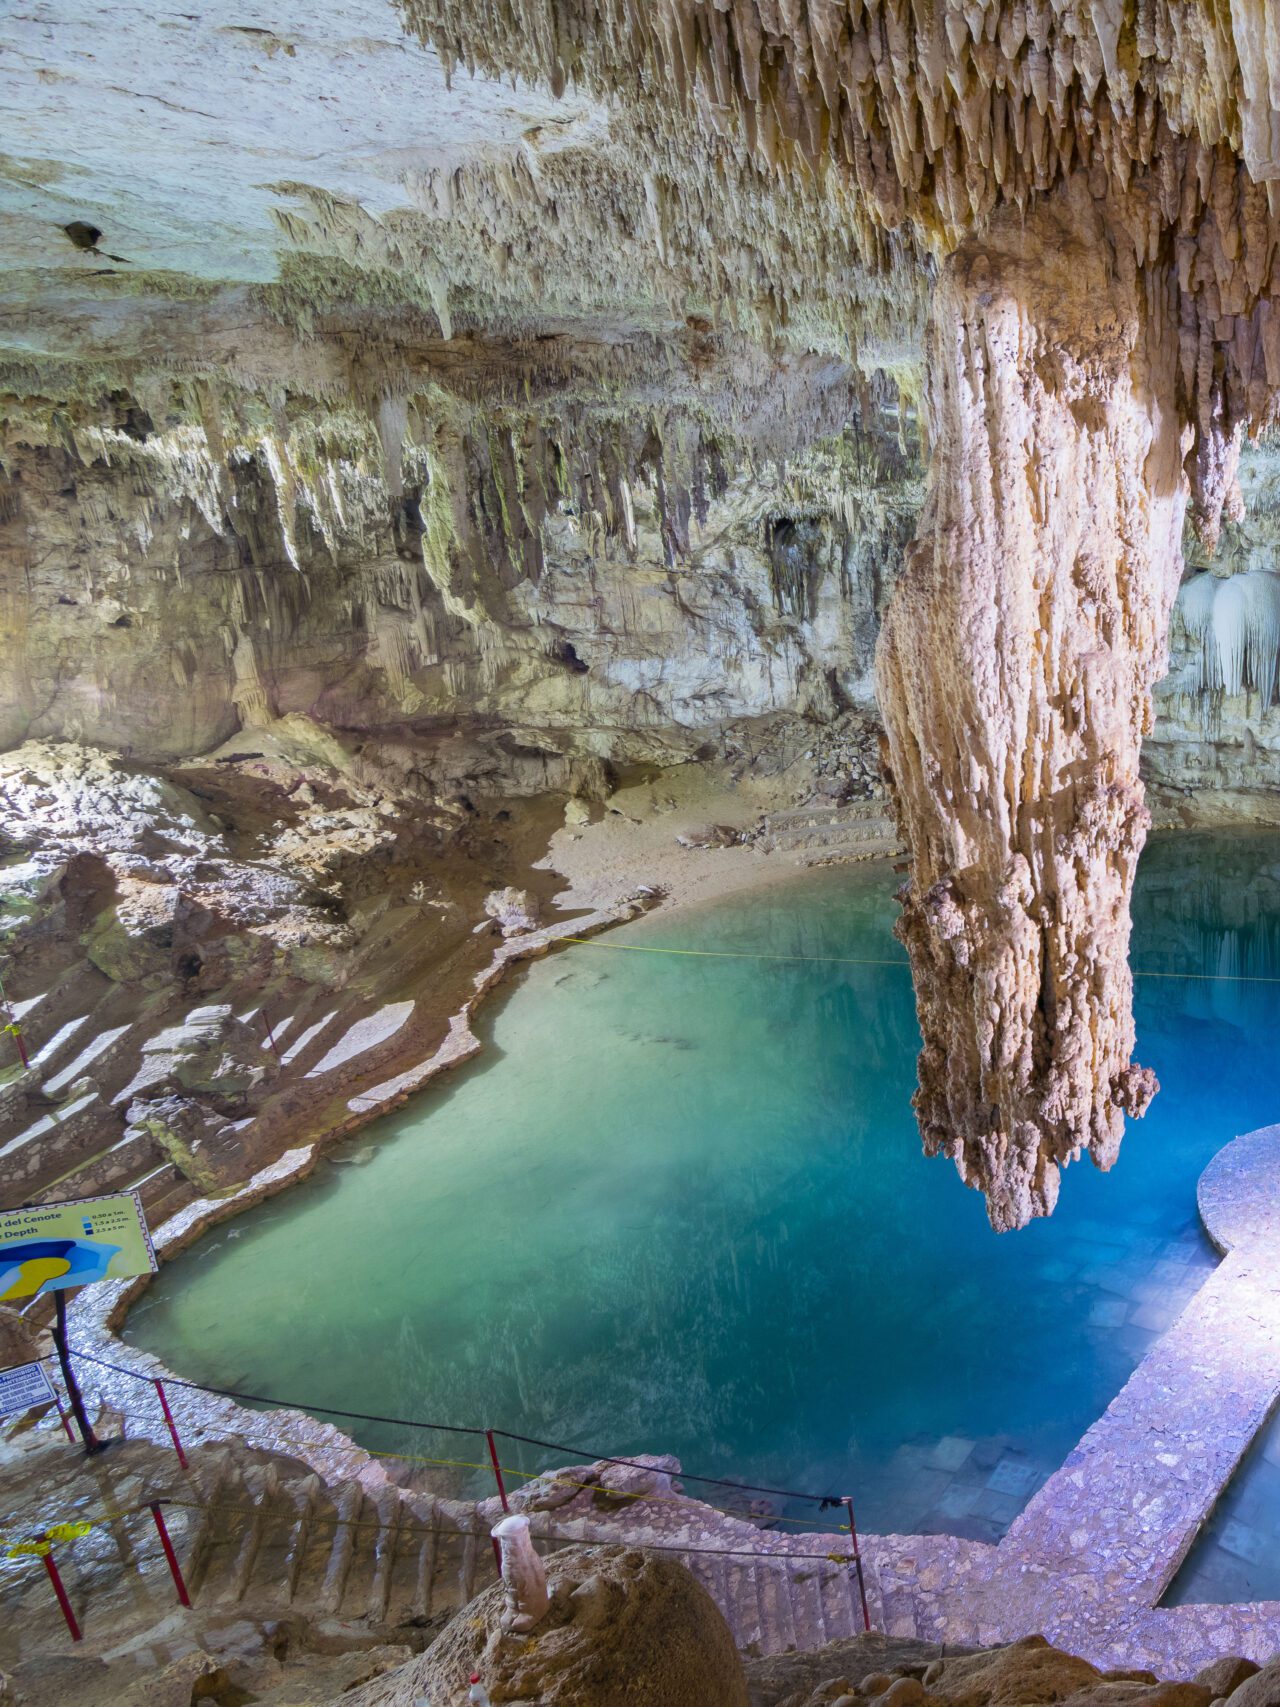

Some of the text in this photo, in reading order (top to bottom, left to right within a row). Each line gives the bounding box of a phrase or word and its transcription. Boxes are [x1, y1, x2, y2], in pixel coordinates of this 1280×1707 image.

[4, 1213, 62, 1227] del Cenote
[4, 1227, 38, 1238] Depth
[2, 1367, 36, 1380] PROHIBIDO
